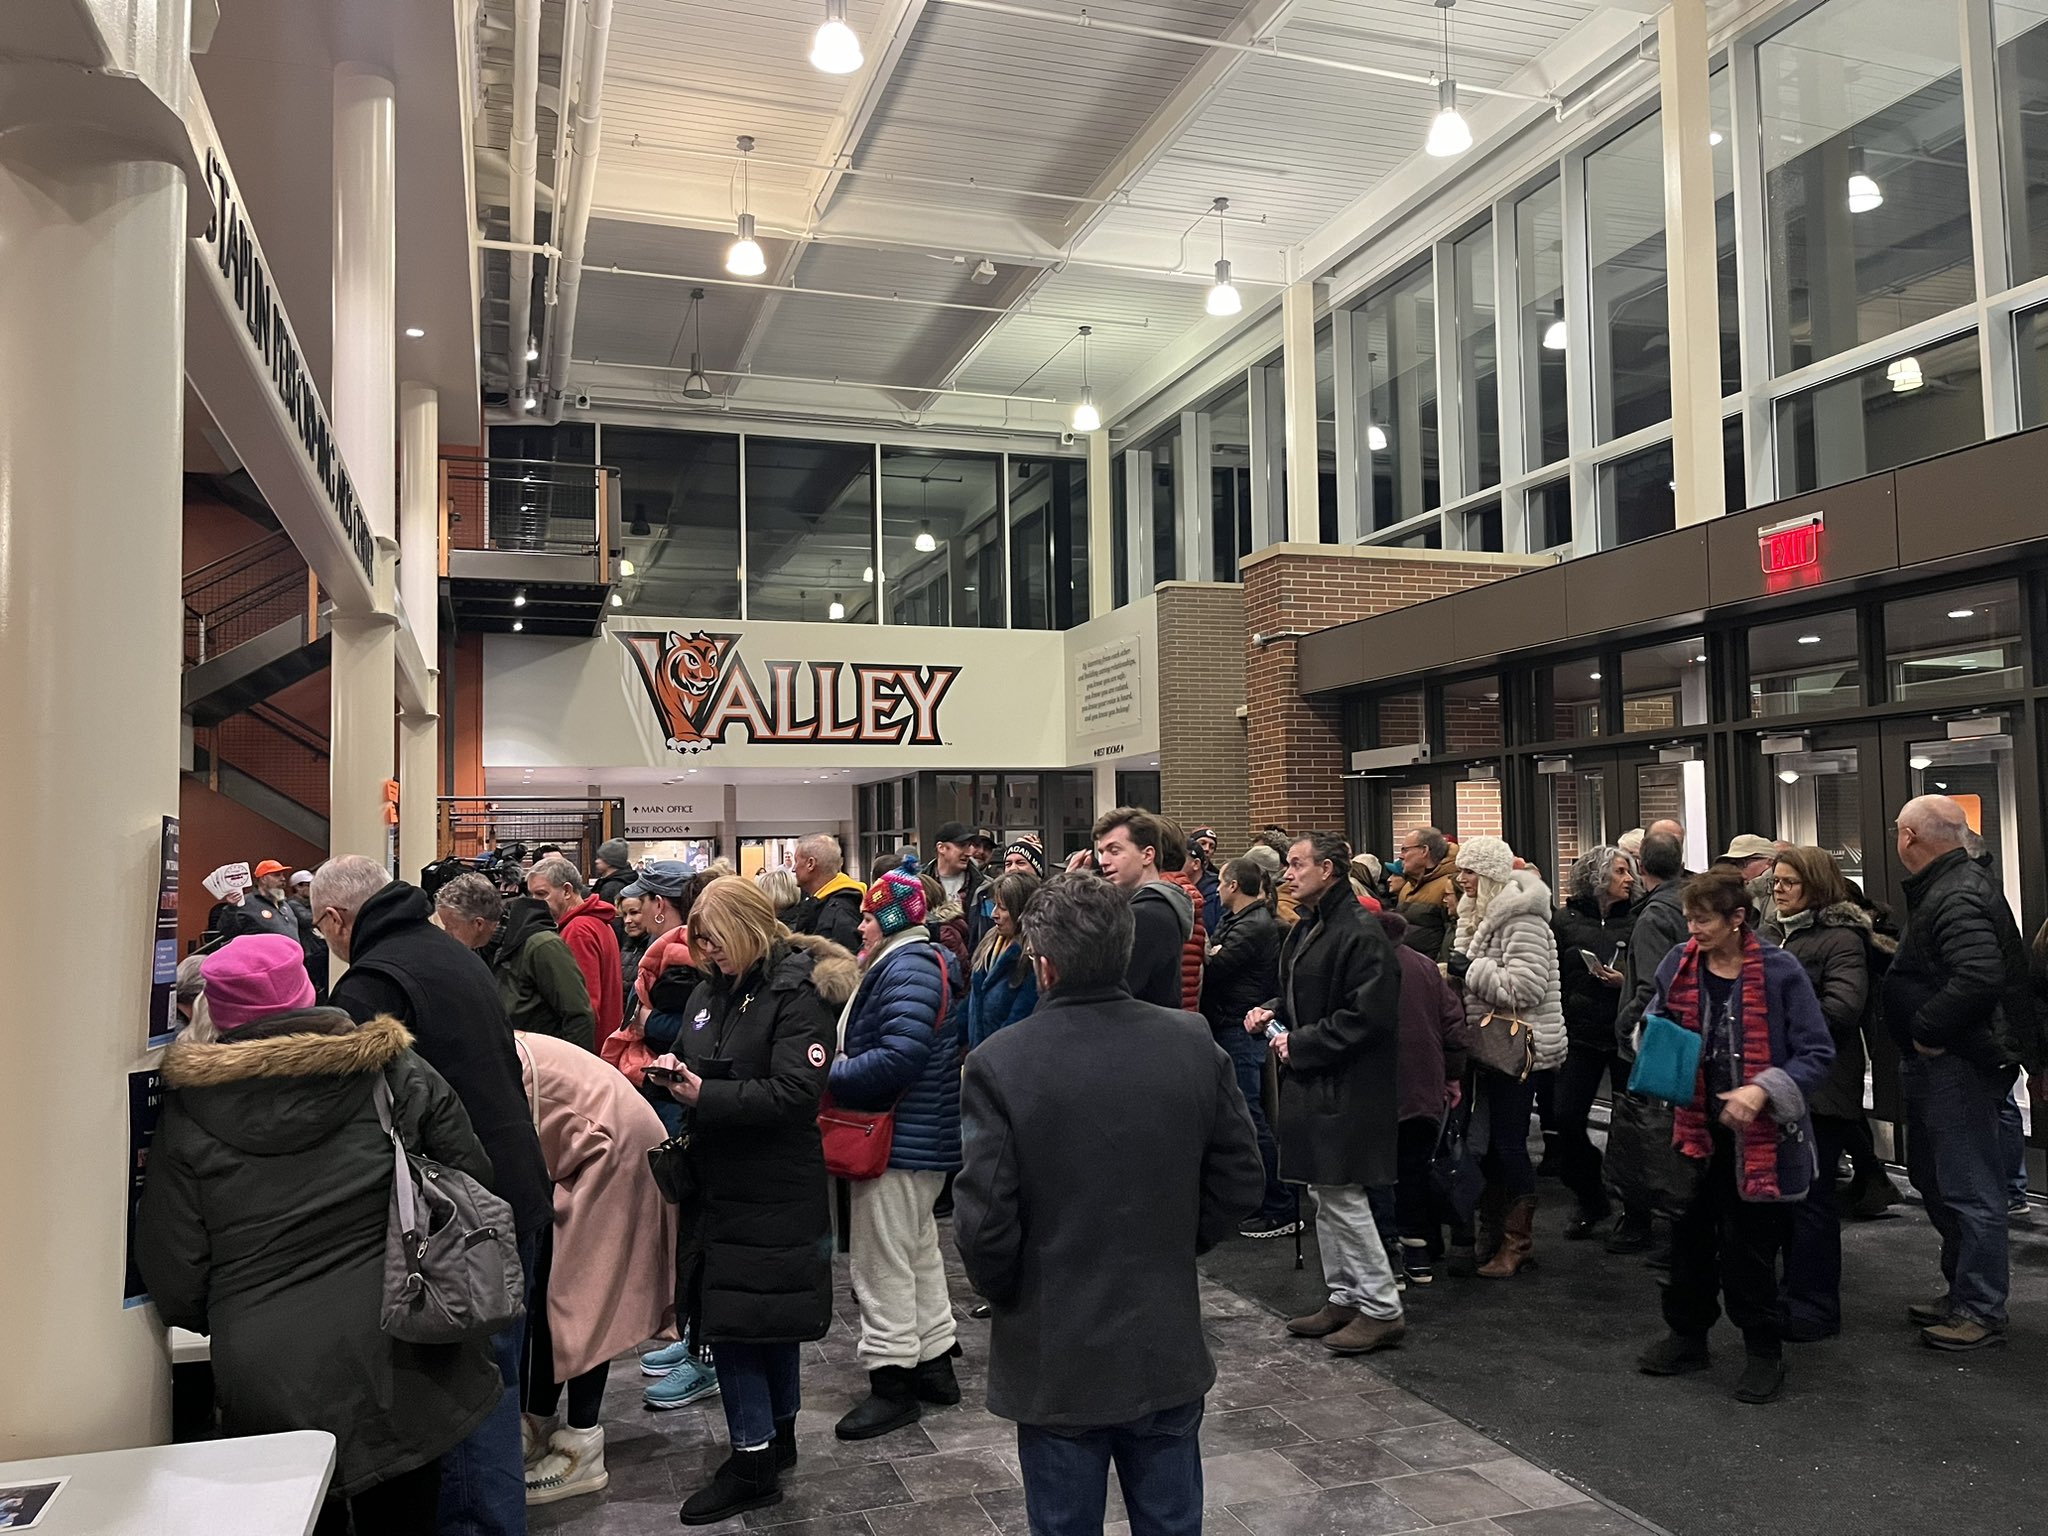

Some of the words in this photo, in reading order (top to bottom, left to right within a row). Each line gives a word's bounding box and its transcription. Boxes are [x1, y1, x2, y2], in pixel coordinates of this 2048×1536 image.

[273, 302, 336, 504] PERFORMING
[335, 461, 353, 540] ARTS
[1770, 531, 1808, 568] EXIT
[611, 630, 963, 746] VALLEY
[641, 805, 664, 814] MAIN
[667, 805, 693, 814] OFFICE
[631, 826, 649, 834] REST
[652, 826, 683, 834] ROOMS
